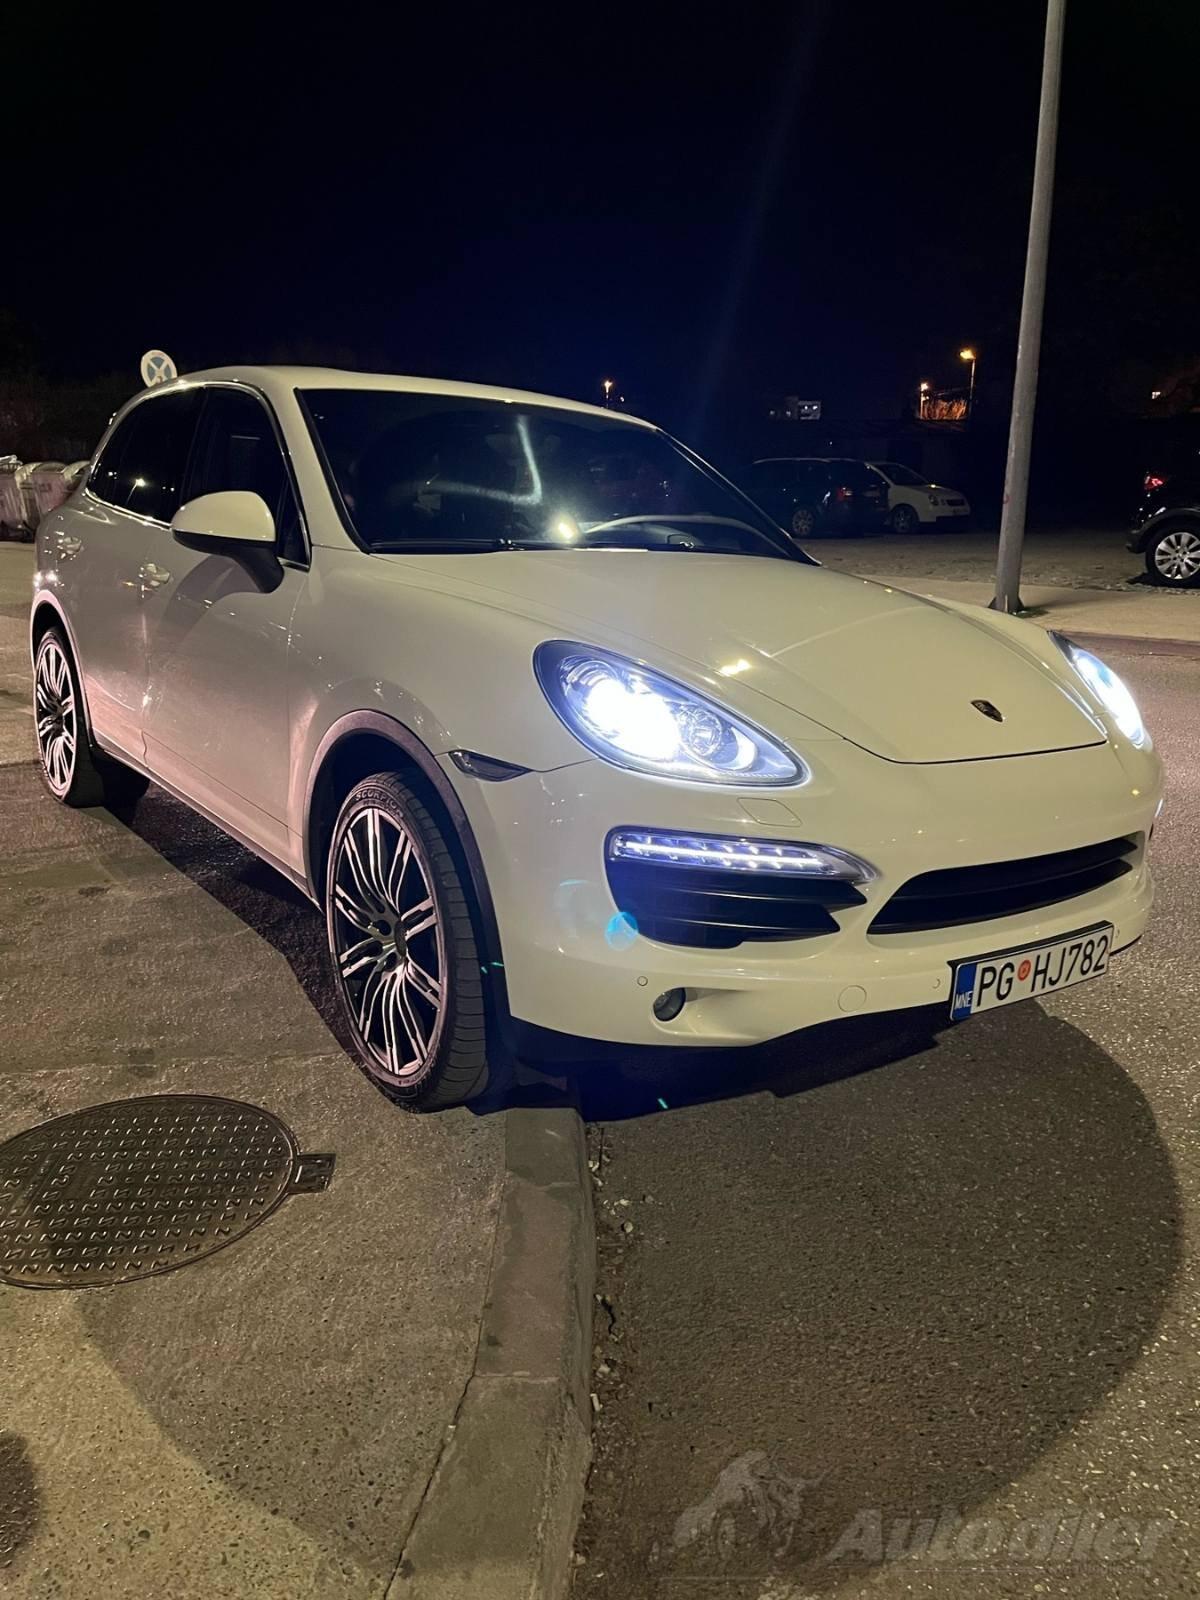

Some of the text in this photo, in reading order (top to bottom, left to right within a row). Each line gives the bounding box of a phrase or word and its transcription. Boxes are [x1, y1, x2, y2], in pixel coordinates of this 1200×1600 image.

[976, 935, 1109, 1007] PG HJ782
[954, 990, 973, 1009] MNE
